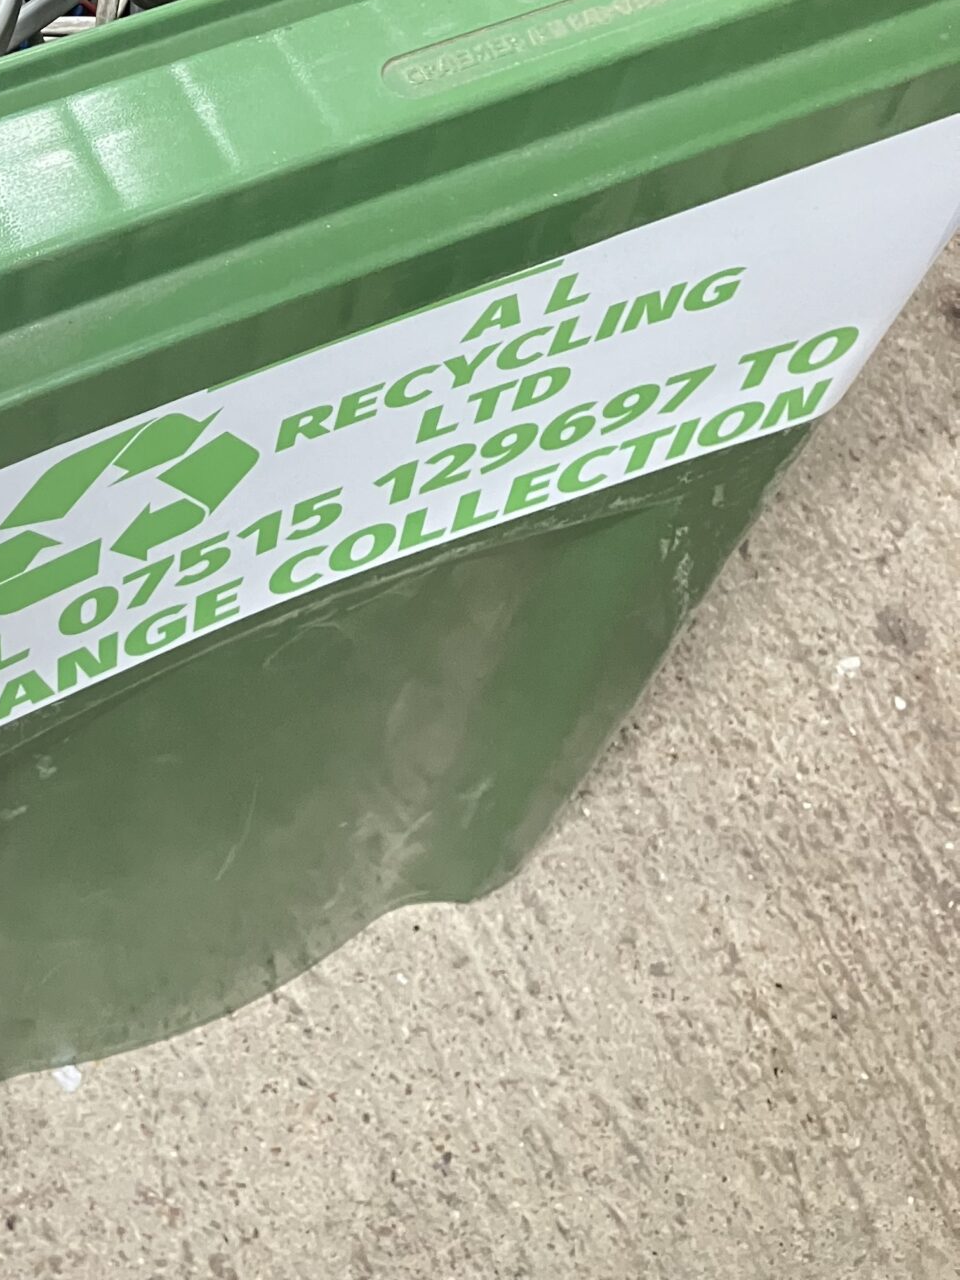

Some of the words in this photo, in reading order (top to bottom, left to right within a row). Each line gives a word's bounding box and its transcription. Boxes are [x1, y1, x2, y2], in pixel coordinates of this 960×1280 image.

[274, 267, 747, 452] RECYCLING
[460, 294, 520, 342] A
[545, 273, 590, 313] L
[58, 487, 343, 636] 07515
[374, 365, 715, 504] 129697
[739, 326, 859, 389] TO
[268, 378, 832, 595] COLLECTION
[416, 366, 571, 444] LTD
